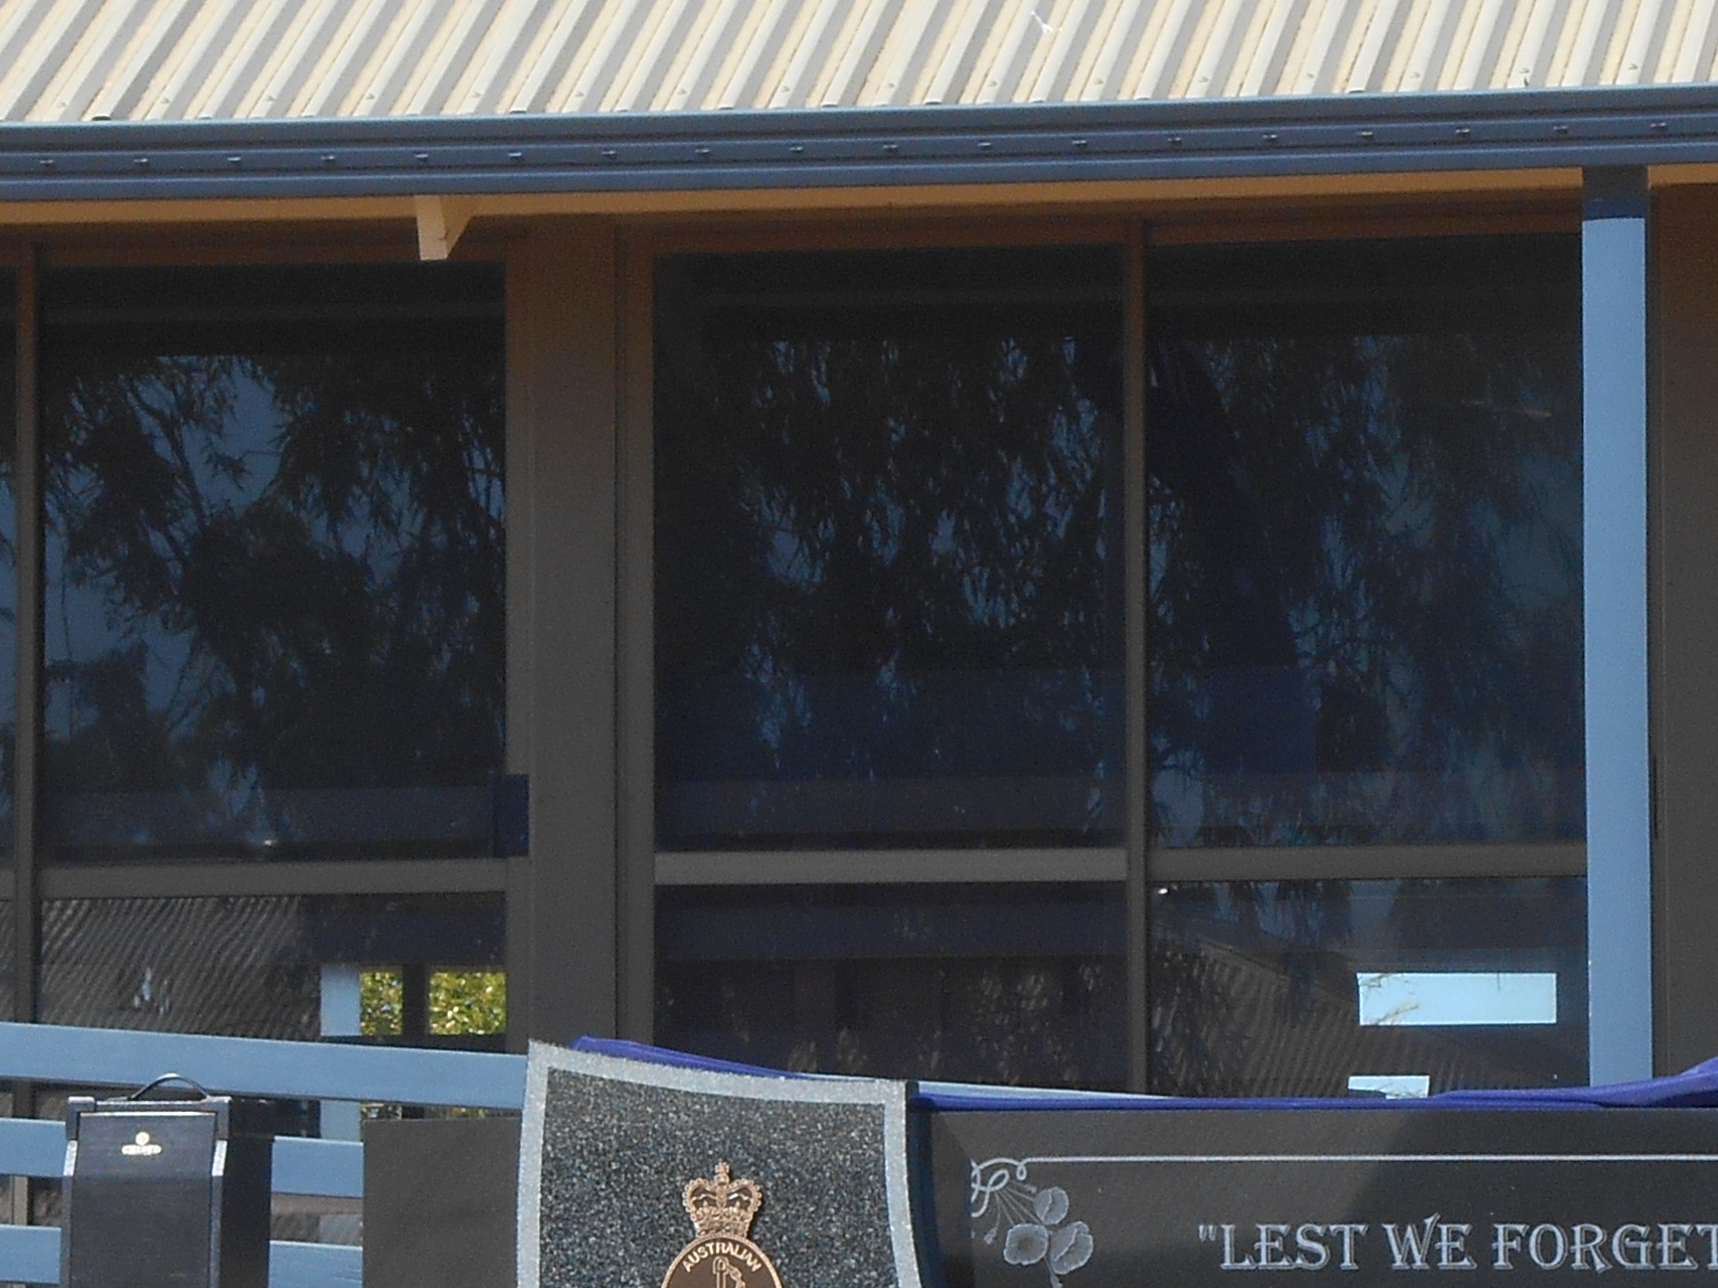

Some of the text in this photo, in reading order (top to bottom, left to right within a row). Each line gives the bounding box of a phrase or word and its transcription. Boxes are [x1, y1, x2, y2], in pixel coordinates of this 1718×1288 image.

[683, 1241, 762, 1273] AUSTRALIAN
[1197, 1223, 1369, 1271] "LEST
[1381, 1212, 1478, 1270] WE
